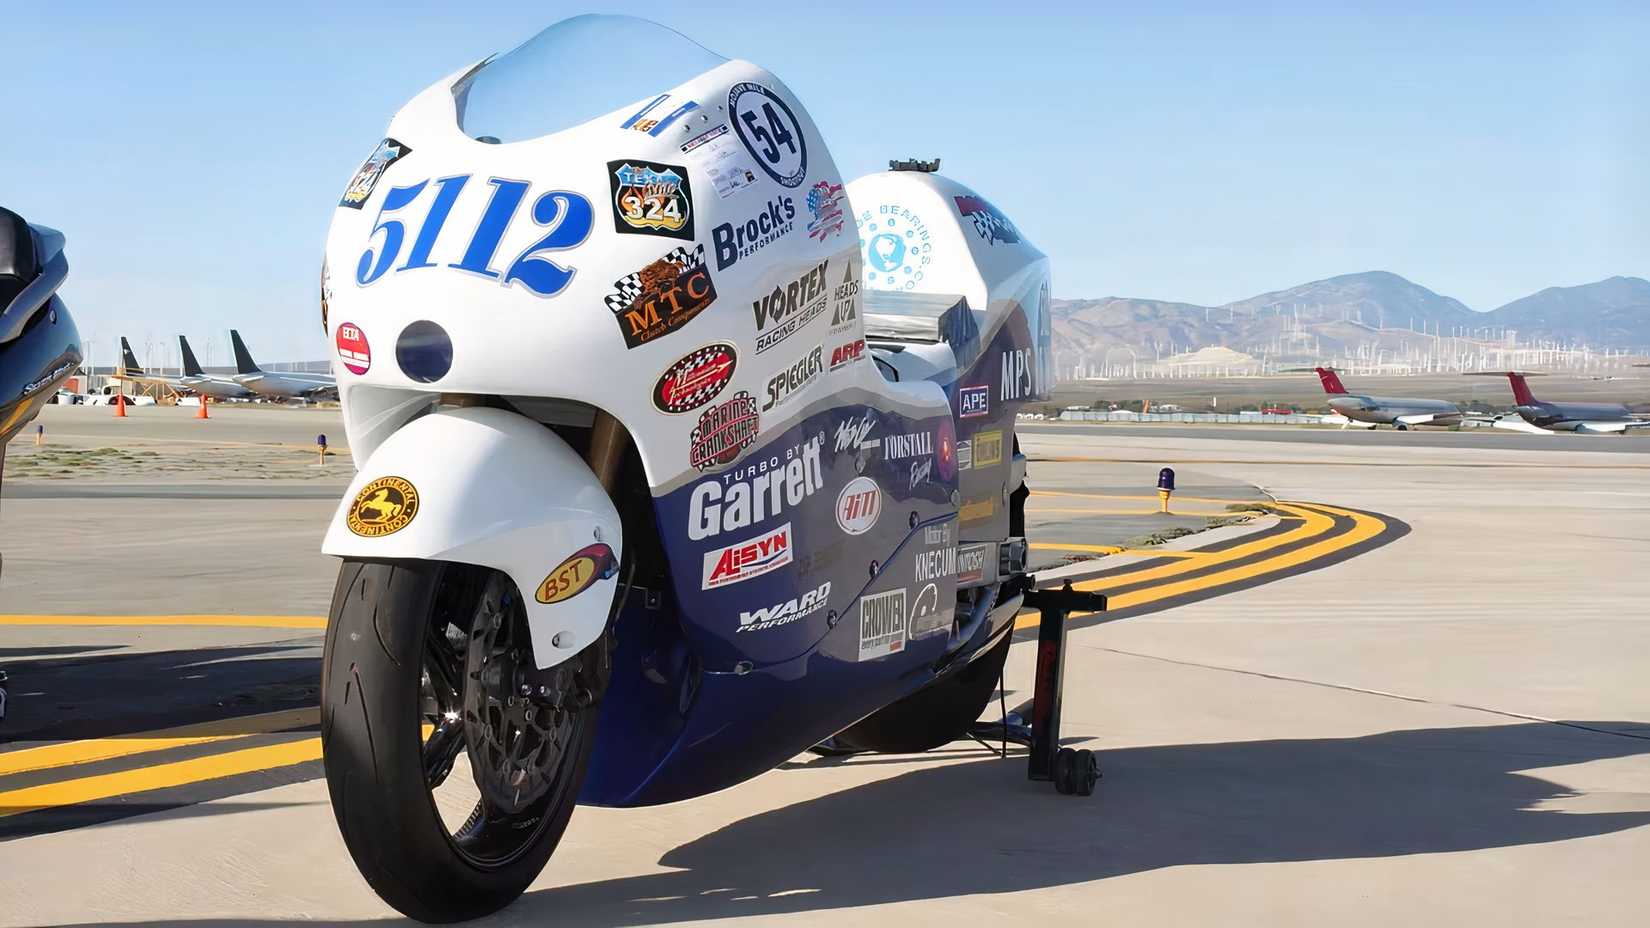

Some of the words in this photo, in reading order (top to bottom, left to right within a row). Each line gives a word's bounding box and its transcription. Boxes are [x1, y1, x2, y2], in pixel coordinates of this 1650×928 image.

[740, 102, 797, 163] 54
[624, 196, 682, 223] 324
[356, 173, 595, 298] 5112
[712, 195, 795, 272] Brock's
[739, 222, 793, 260] PERFORMANCE
[624, 271, 710, 337] MTC
[752, 259, 829, 331] VORTEX
[834, 280, 859, 301] HEADS
[756, 320, 796, 352] RACING
[831, 339, 866, 367] ARP
[762, 345, 823, 412] SPIEGLER
[1000, 348, 1032, 401] MPS
[962, 390, 987, 410] APE
[723, 456, 779, 485] TURBO
[786, 443, 801, 460] BY
[543, 559, 584, 601] BST
[736, 597, 828, 633] PERFORMANCE
[739, 581, 832, 626] WARD
